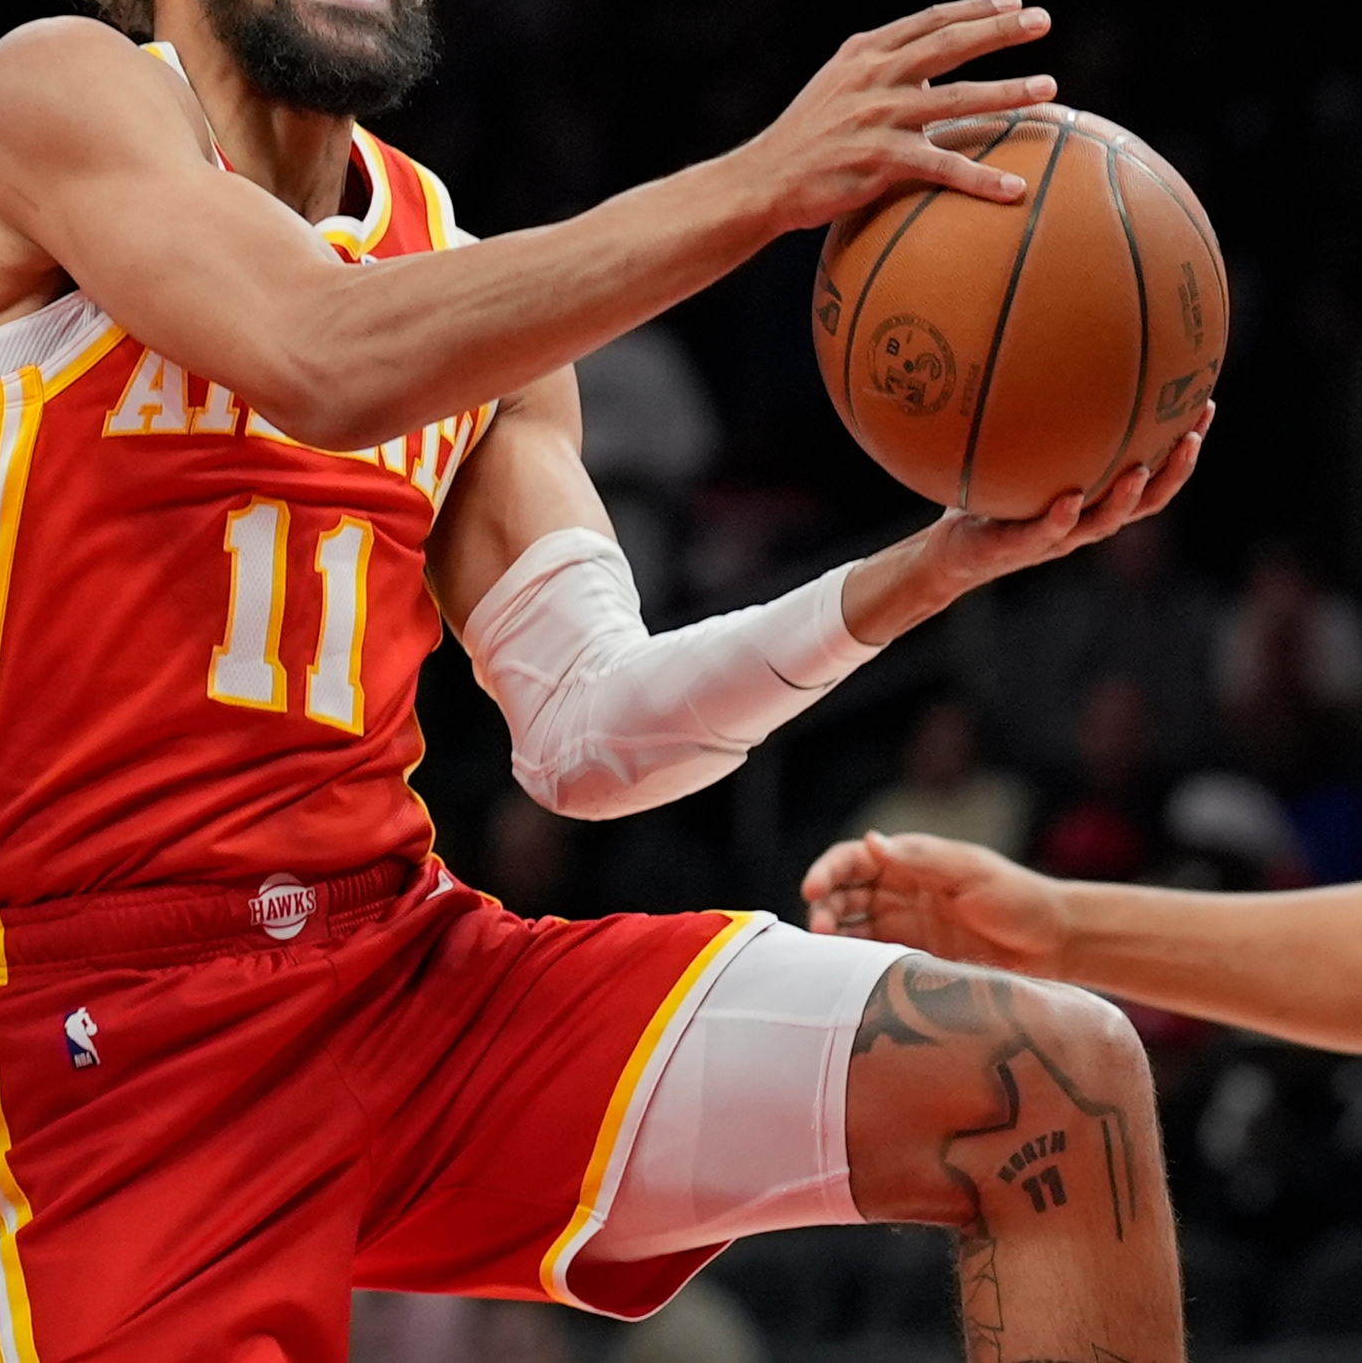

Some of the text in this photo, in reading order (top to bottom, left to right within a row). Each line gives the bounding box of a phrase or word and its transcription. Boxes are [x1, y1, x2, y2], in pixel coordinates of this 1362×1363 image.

[207, 495, 373, 736] 11
[249, 887, 316, 926] HAWKS
[1022, 1165, 1067, 1213] 11
